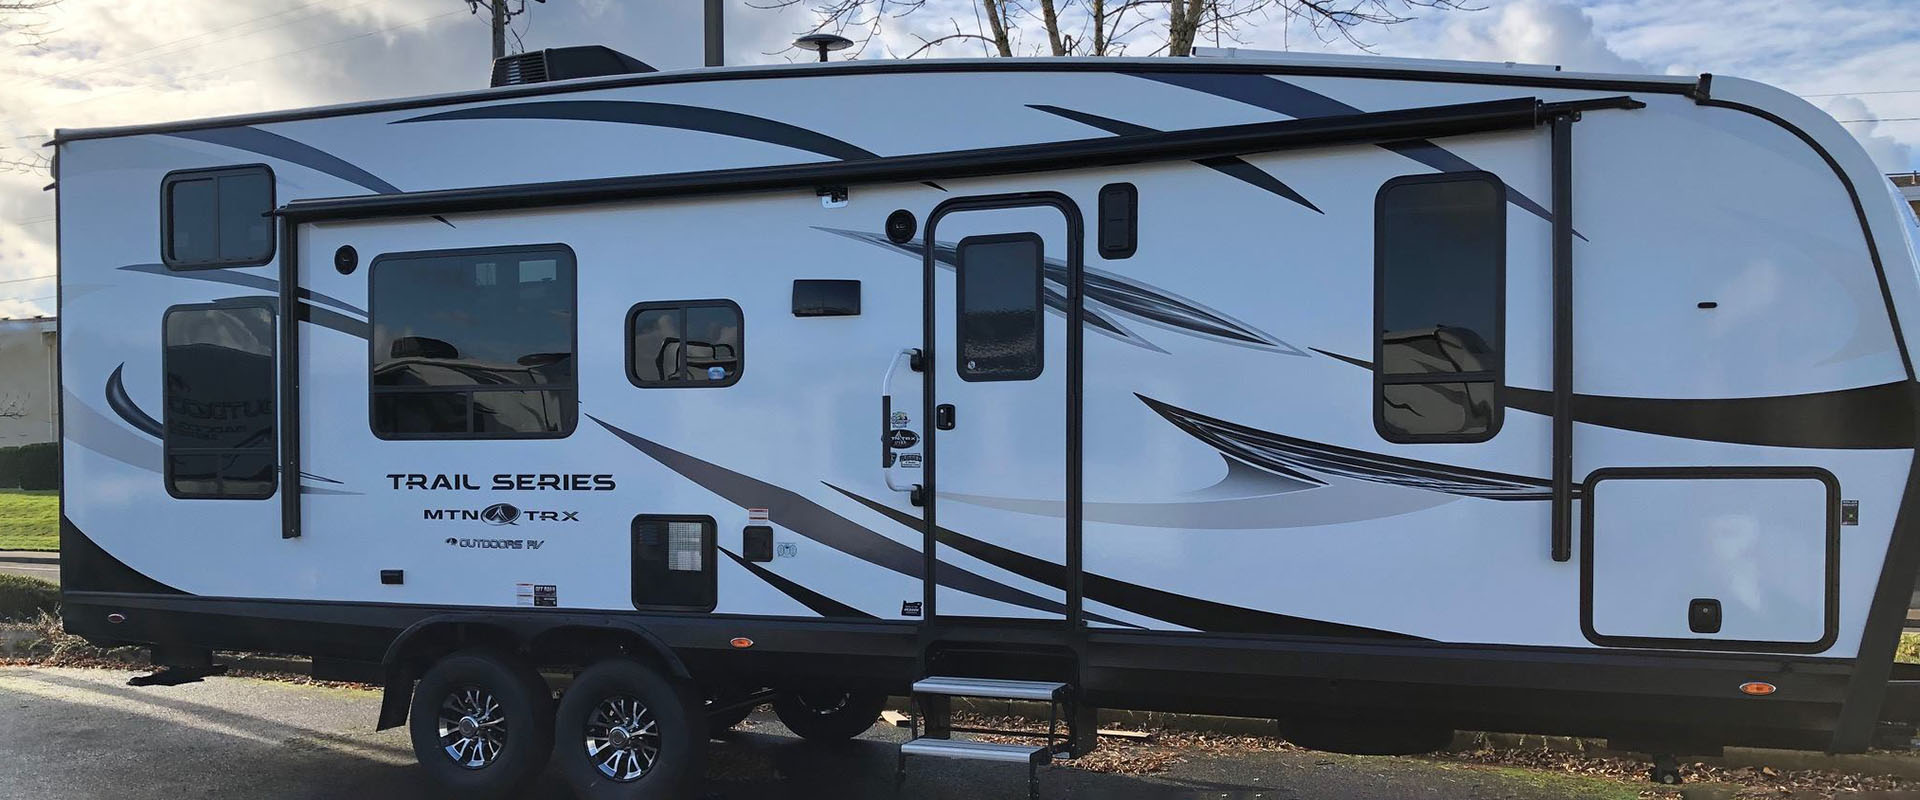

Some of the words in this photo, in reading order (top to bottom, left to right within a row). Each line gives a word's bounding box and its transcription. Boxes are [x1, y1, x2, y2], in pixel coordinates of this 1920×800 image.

[386, 474, 481, 491] TRAIL
[491, 474, 616, 491] SERIES
[423, 509, 478, 520] MTN
[523, 511, 580, 521] TRX
[459, 538, 523, 550] OUTDOORS
[526, 539, 545, 550] RV
